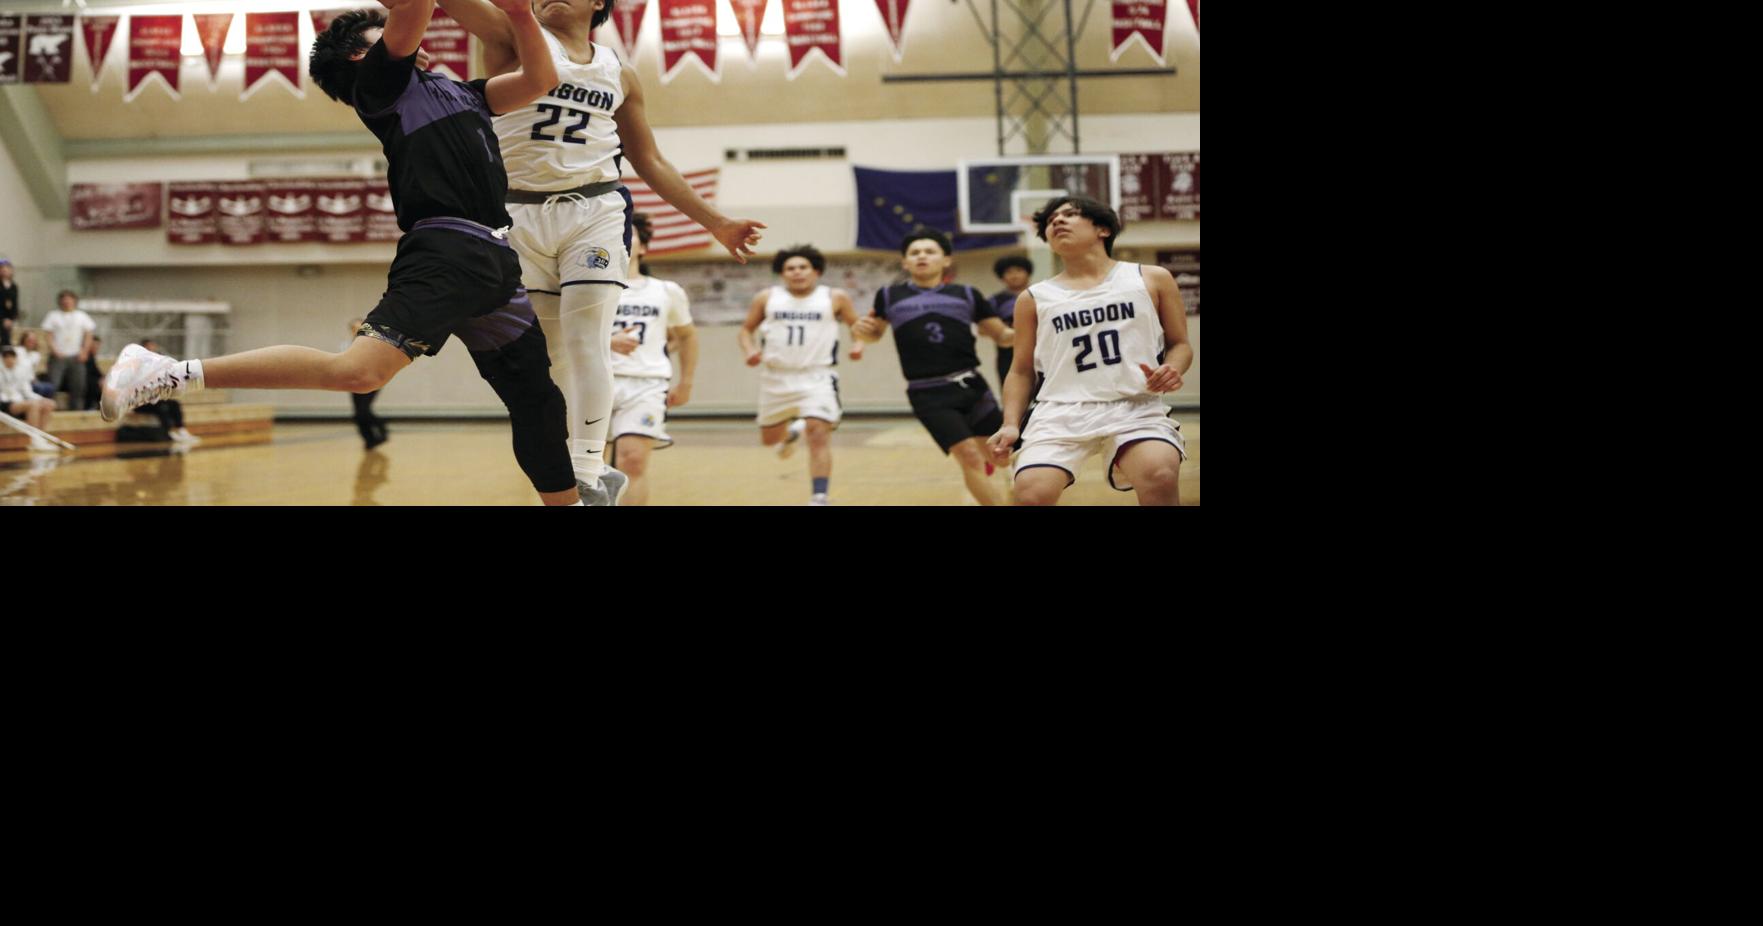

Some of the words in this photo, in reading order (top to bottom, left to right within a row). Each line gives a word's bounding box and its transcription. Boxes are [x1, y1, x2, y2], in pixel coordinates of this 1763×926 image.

[548, 83, 613, 111] GOON
[531, 103, 590, 144] 22
[616, 304, 659, 316] GOON
[1052, 302, 1135, 334] ANGOON
[787, 325, 804, 346] 11
[924, 321, 944, 343] 3
[1072, 329, 1121, 373] 20
